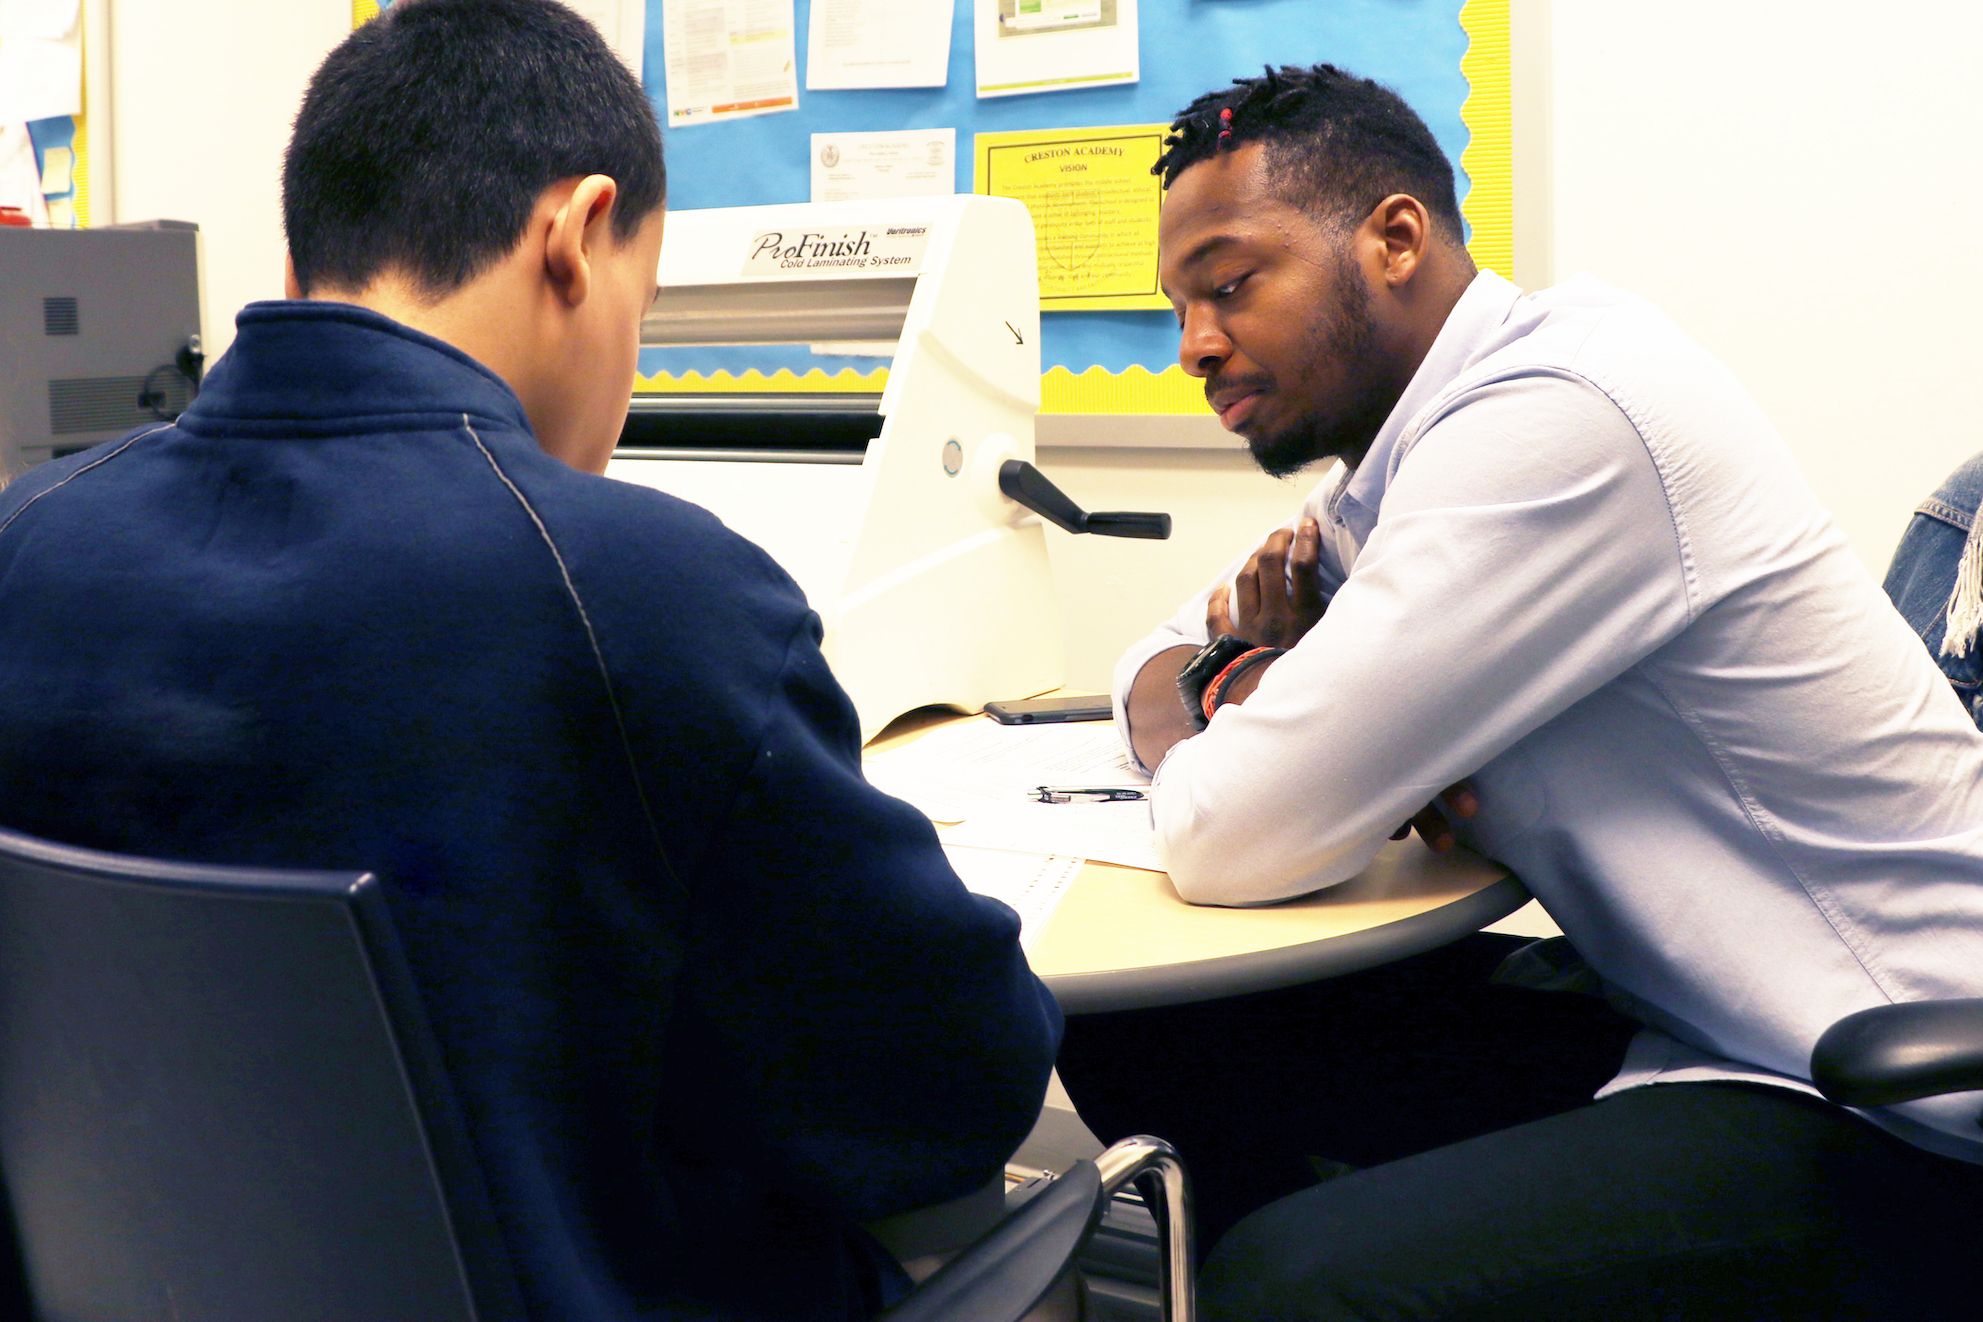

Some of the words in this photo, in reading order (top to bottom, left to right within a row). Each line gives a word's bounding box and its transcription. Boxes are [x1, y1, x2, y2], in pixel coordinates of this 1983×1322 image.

[1023, 147, 1071, 163] CRESTON
[1074, 146, 1125, 157] ACADEMY
[1059, 163, 1088, 173] VISION
[752, 231, 871, 260] ProFinish
[780, 258, 805, 269] Cold
[806, 256, 867, 268] Laminating
[870, 255, 912, 267] System
